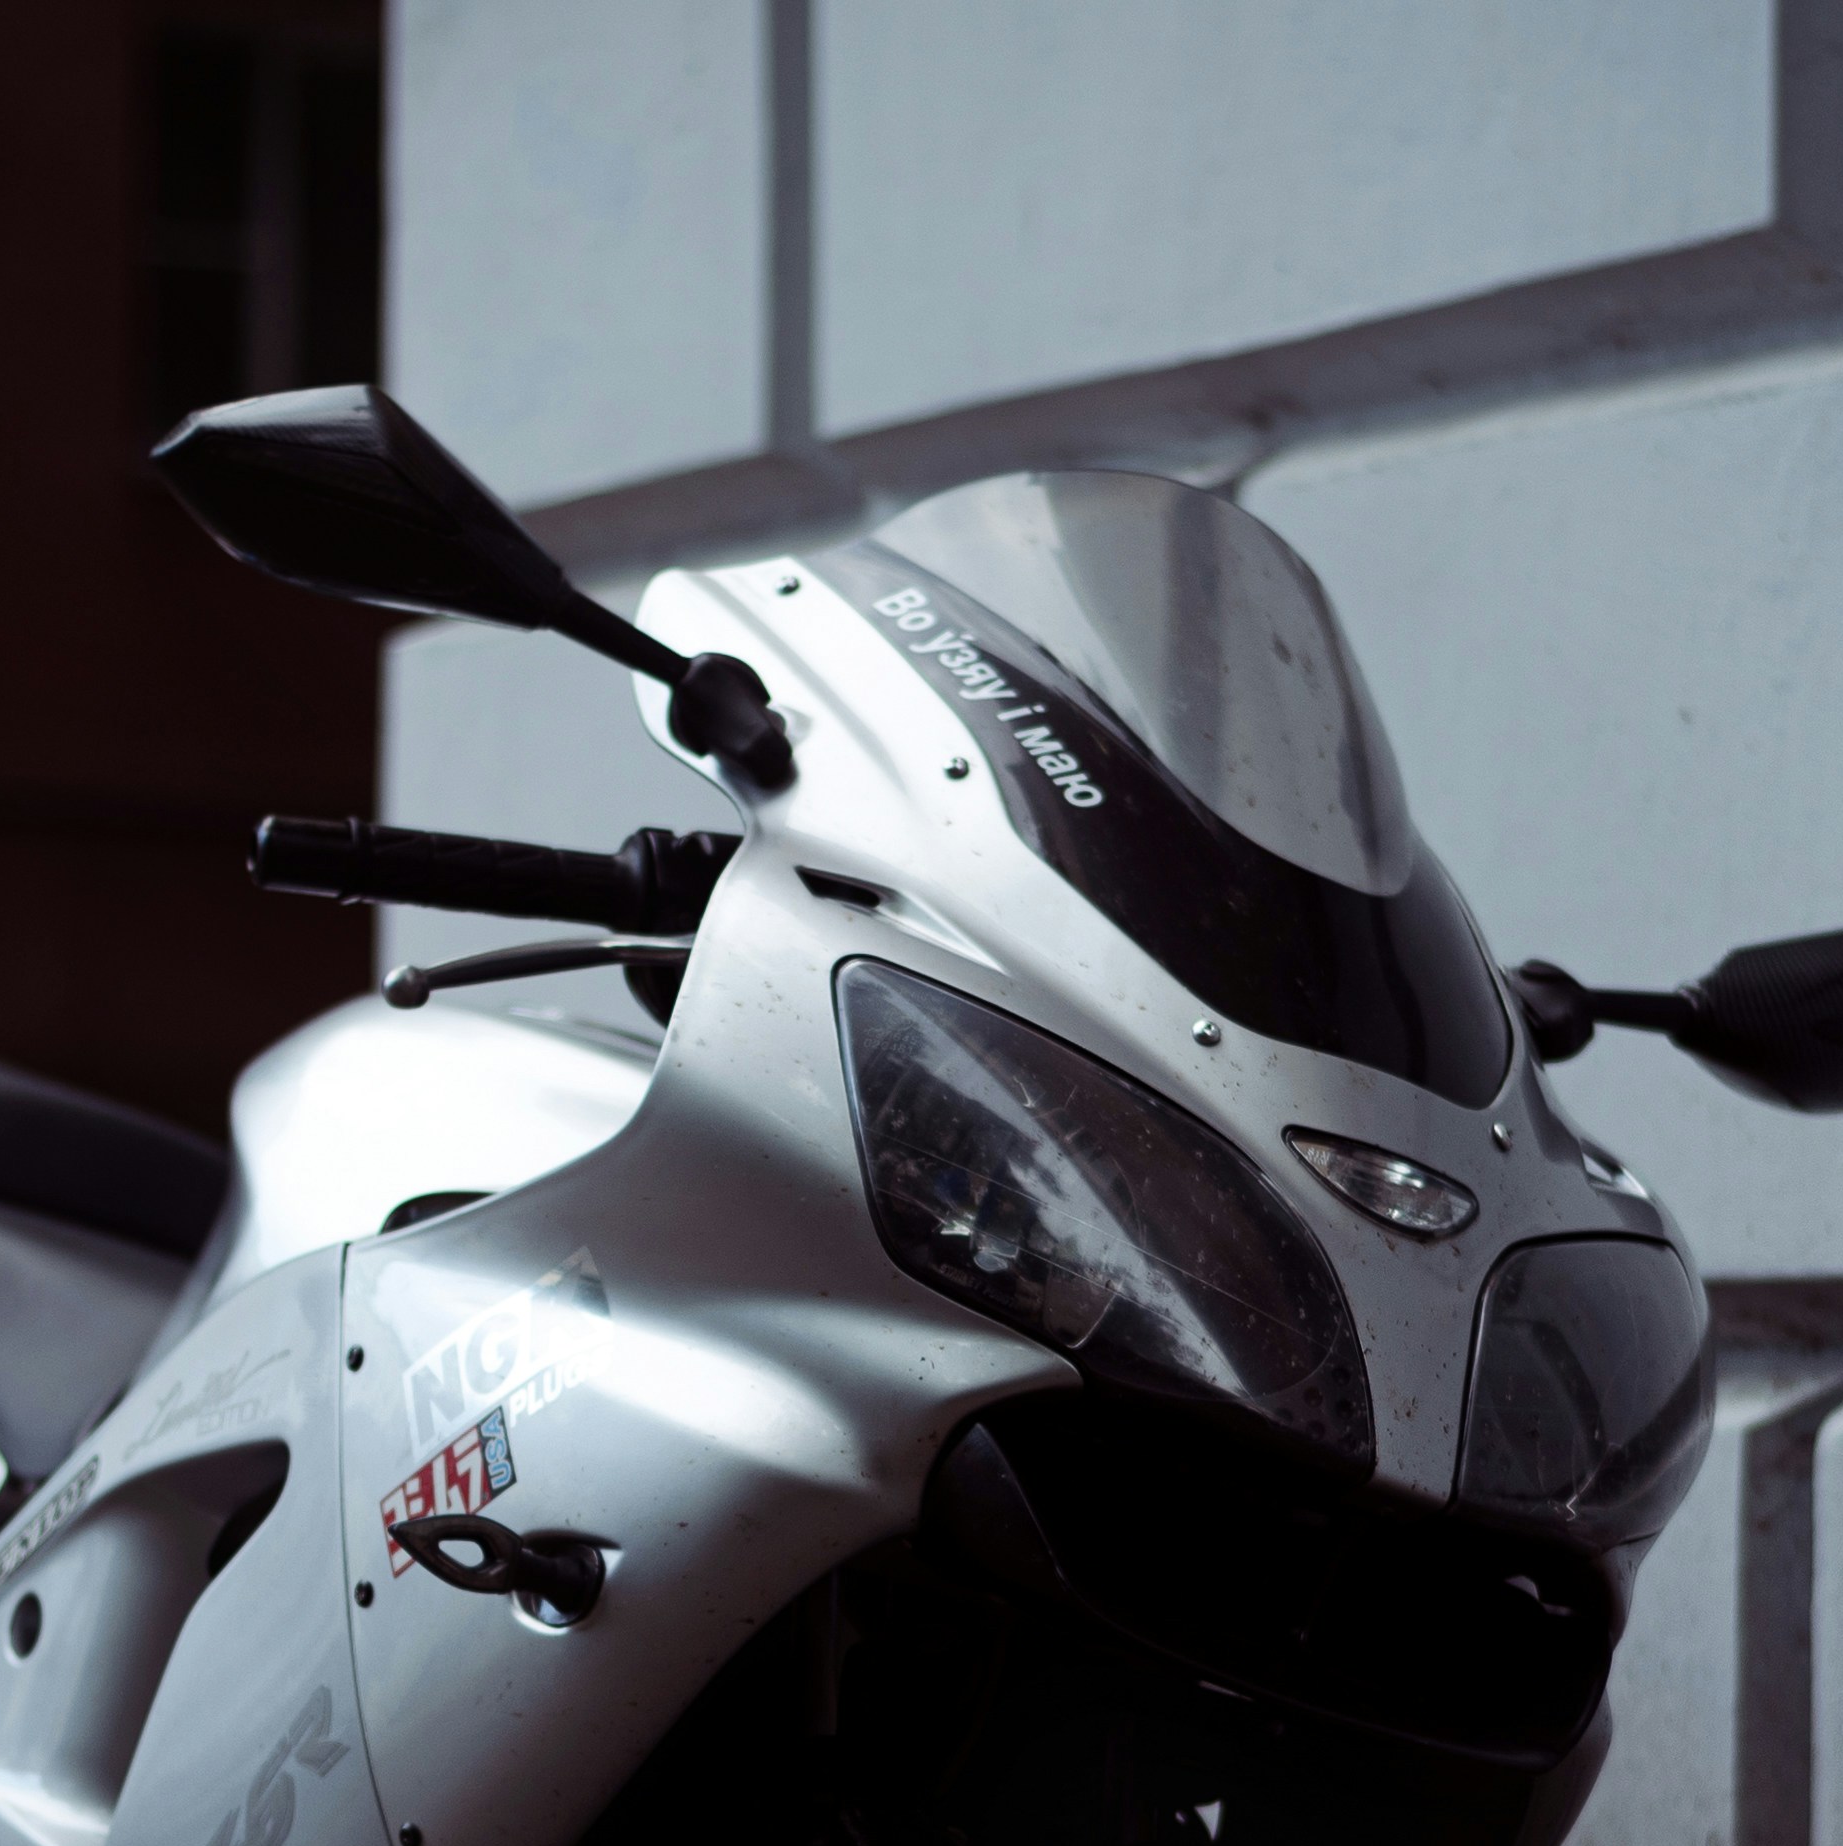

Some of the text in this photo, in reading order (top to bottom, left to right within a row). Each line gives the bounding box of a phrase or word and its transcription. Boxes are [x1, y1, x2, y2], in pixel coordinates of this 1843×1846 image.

[872, 587, 936, 632] Во
[1013, 726, 1103, 808] маю
[409, 1262, 600, 1449] NGK
[479, 1410, 513, 1490] USA
